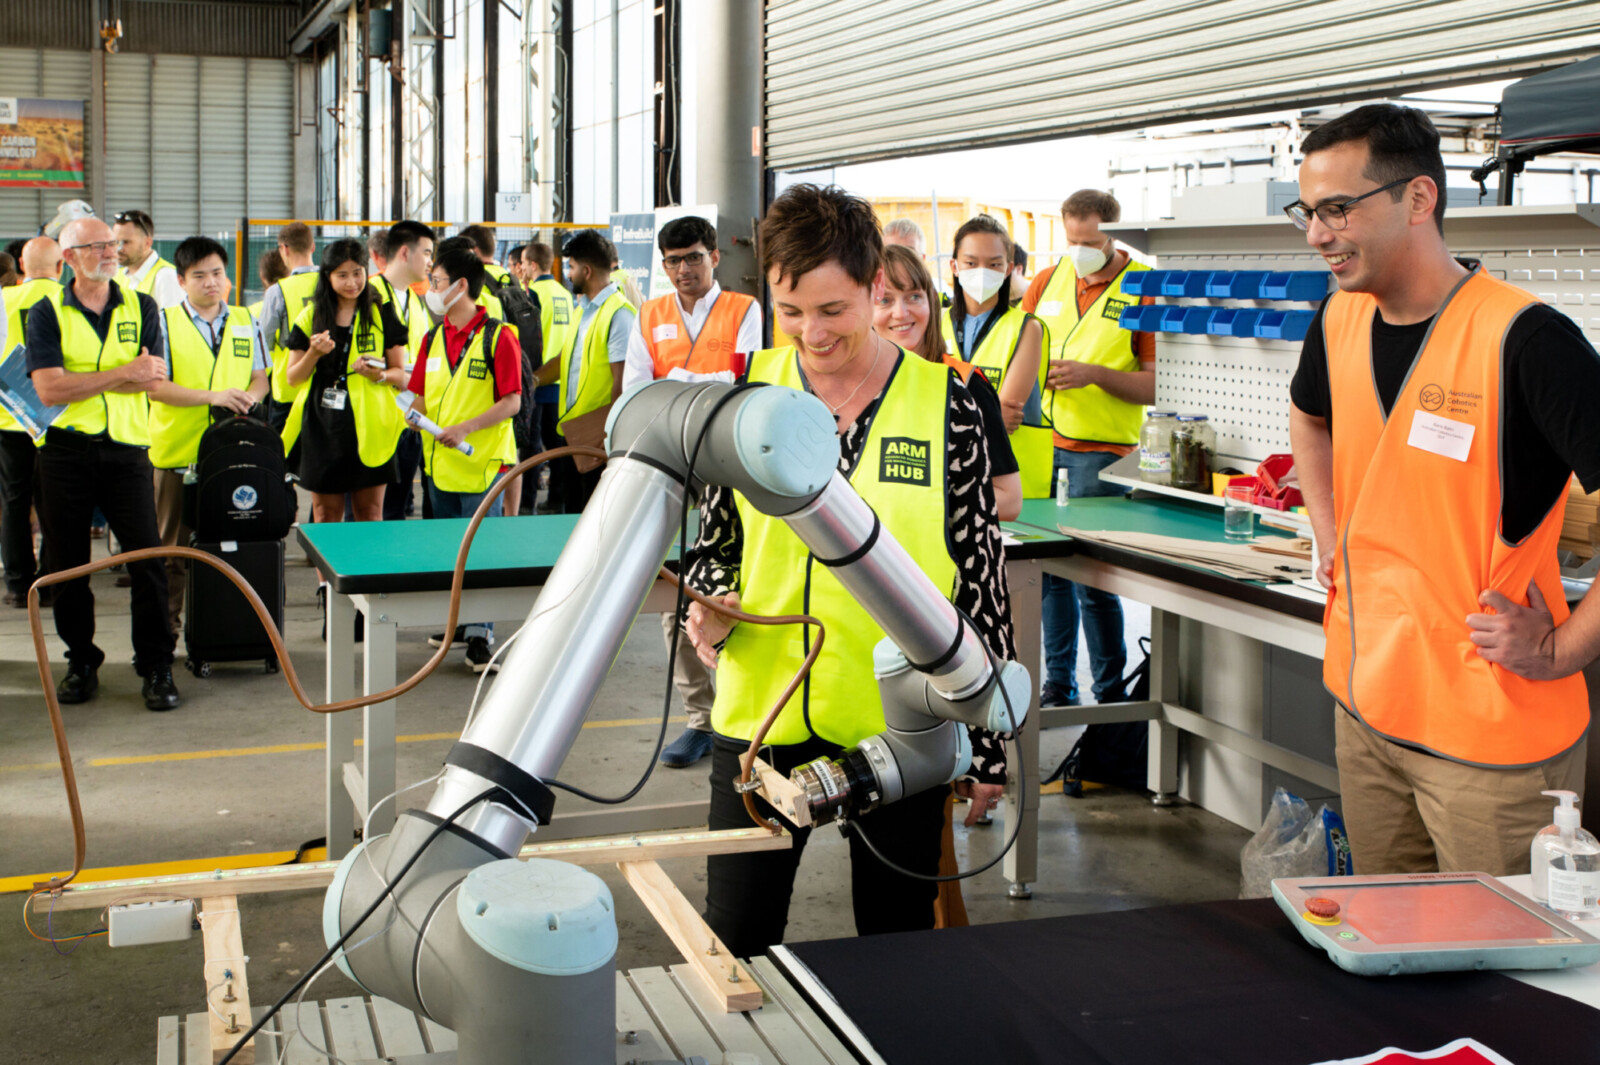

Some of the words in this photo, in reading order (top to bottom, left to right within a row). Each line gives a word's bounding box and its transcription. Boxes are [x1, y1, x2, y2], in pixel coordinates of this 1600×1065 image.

[1, 136, 37, 147] CARBON
[511, 203, 517, 211] 2
[119, 323, 137, 332] ARM
[121, 333, 137, 342] HUB
[469, 370, 485, 378] HUB
[984, 368, 1000, 378] RM
[1448, 389, 1483, 400] Australian
[1447, 397, 1478, 408] Cobotics
[1446, 405, 1469, 415] Centre
[885, 441, 927, 459] ARM
[885, 463, 925, 481] HUB
